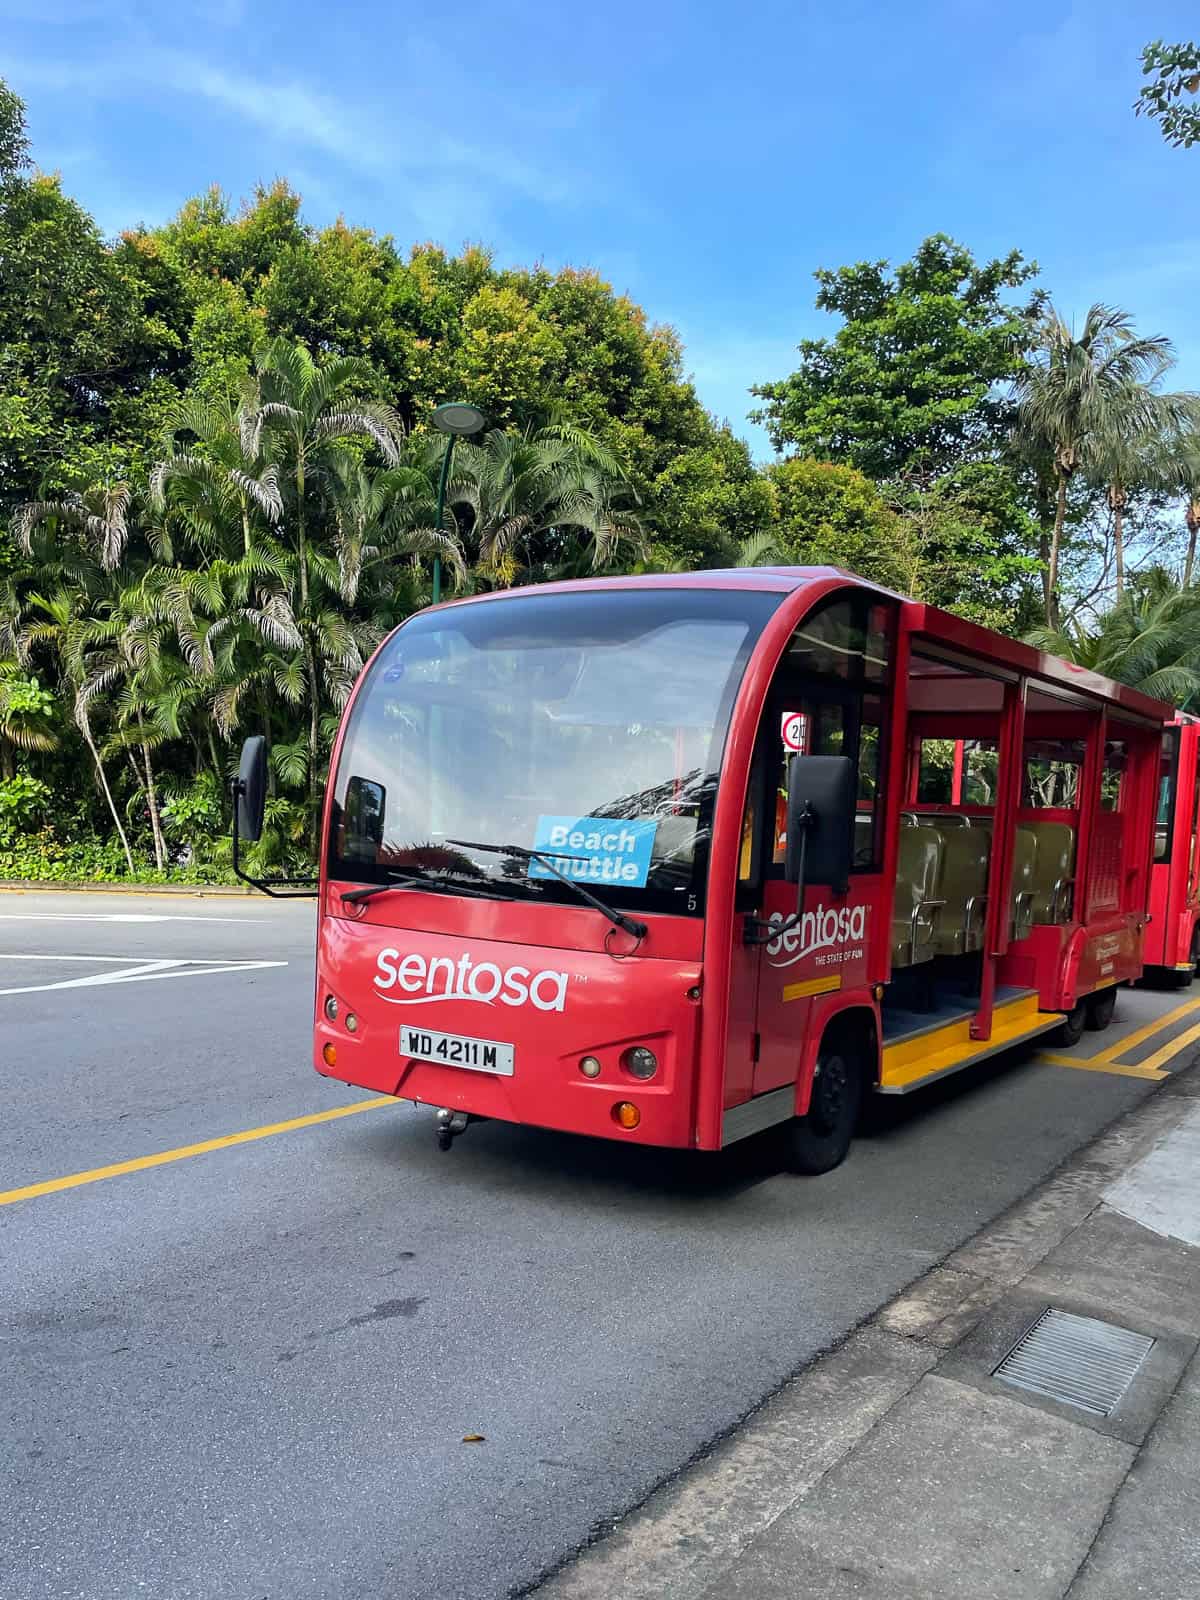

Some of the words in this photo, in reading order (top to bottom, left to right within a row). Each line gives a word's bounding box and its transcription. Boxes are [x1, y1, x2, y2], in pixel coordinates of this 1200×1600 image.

[550, 825, 635, 852] Beach
[687, 894, 697, 911] 5
[373, 948, 569, 1012] sentosa
[408, 1031, 433, 1056] WD
[436, 1038, 479, 1065] 4211
[483, 1045, 497, 1068] M
